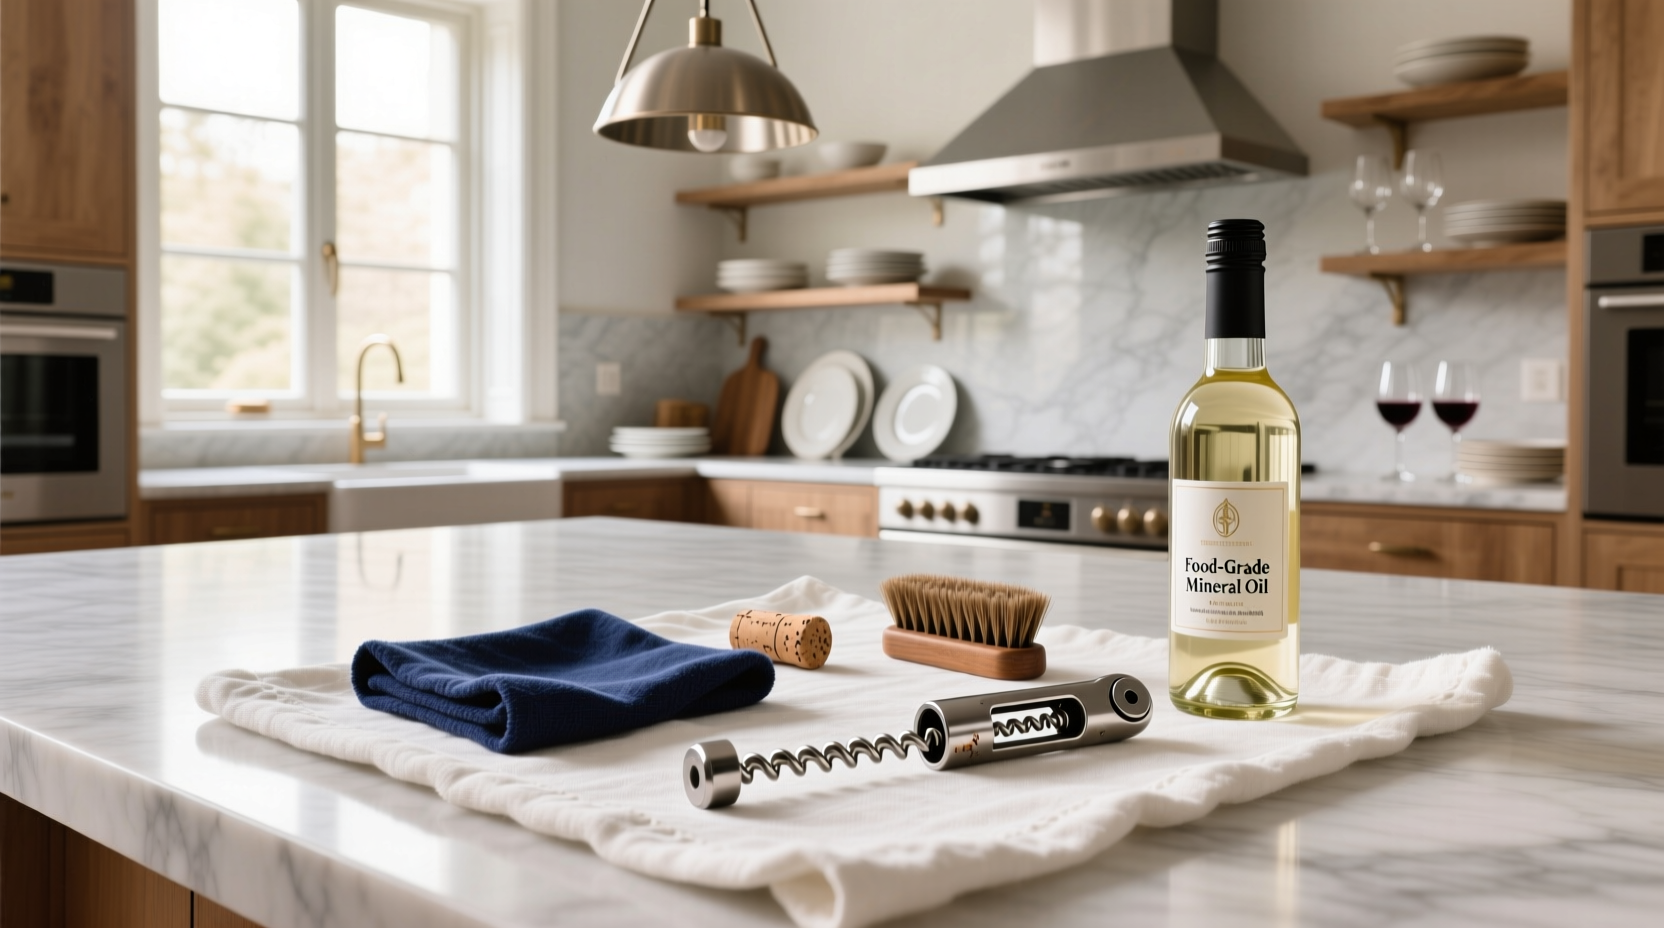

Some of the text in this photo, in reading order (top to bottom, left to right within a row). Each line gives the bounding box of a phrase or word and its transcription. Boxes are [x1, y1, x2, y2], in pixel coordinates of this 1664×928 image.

[1185, 557, 1270, 575] Food-Grade
[1186, 577, 1268, 594] Mineral Oil
